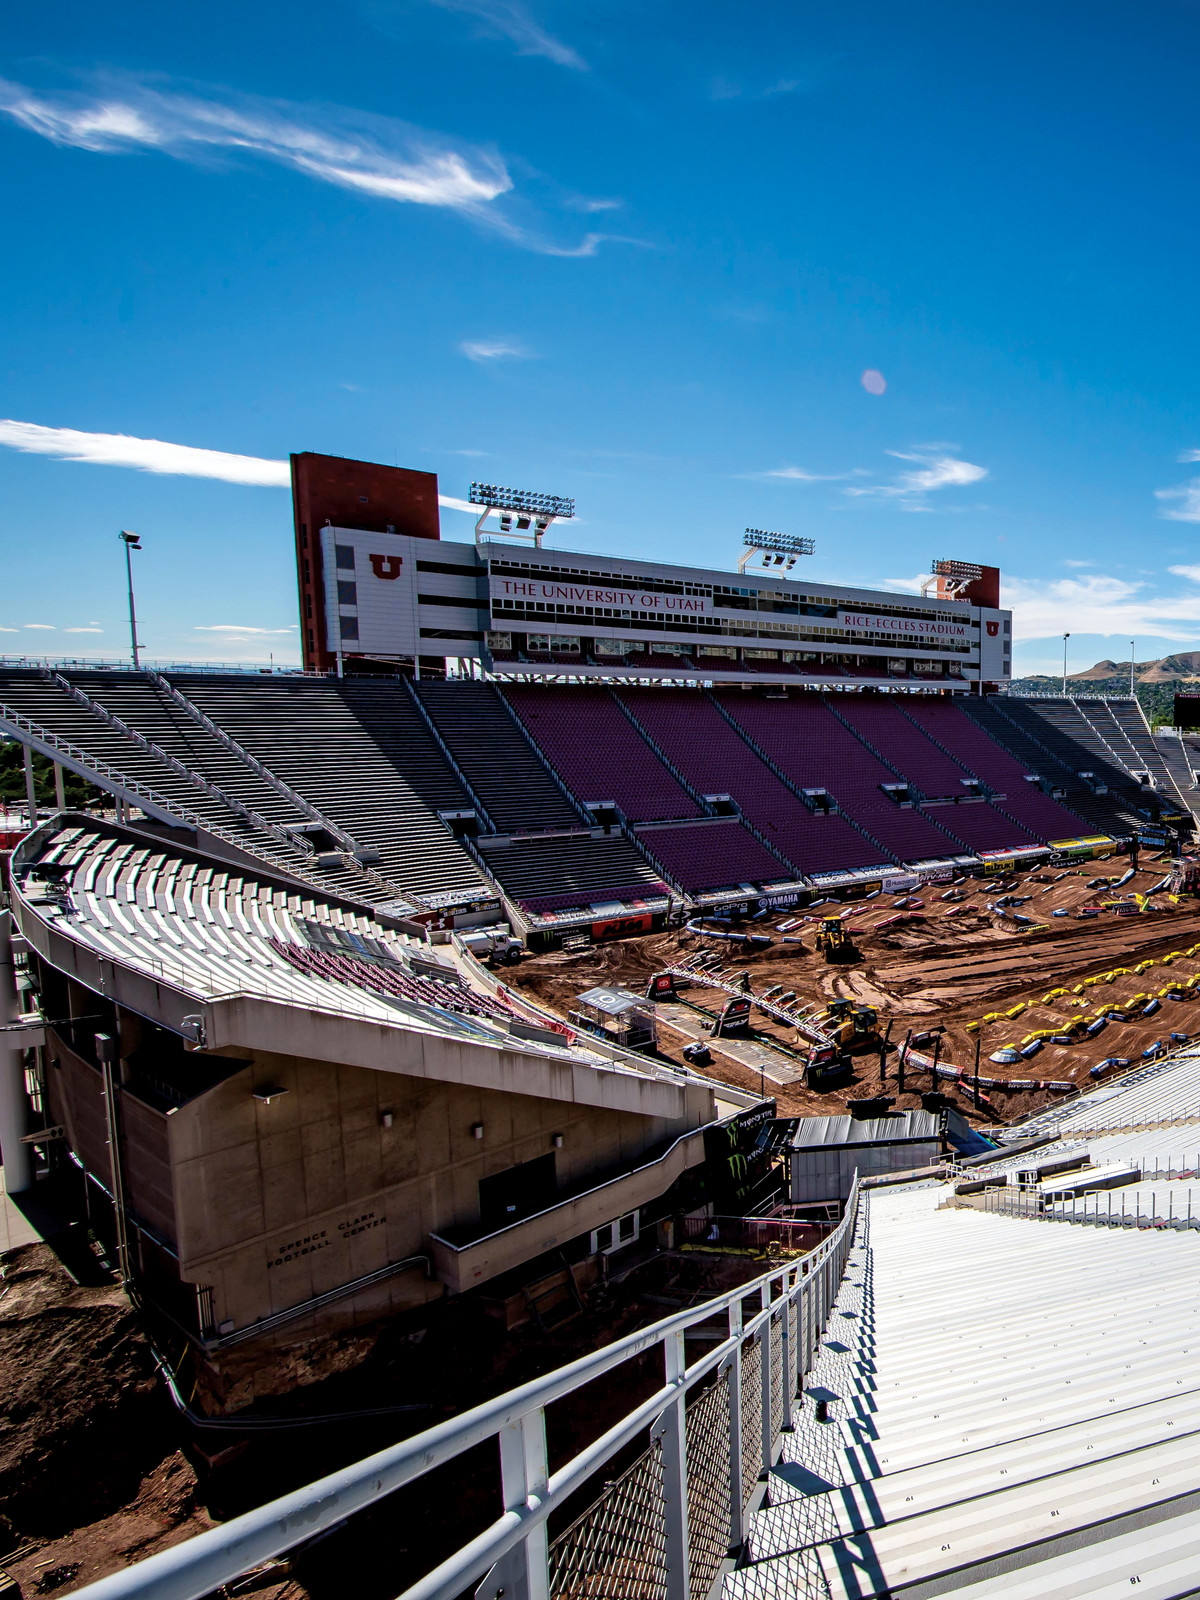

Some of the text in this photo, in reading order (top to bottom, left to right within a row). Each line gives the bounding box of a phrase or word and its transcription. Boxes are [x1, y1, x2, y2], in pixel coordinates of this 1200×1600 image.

[368, 553, 403, 580] U
[502, 580, 705, 612] THE UNIVERSITY OF UTAH
[844, 615, 965, 635] RICE-ECCLES STADIUM
[985, 620, 1000, 637] U
[985, 861, 1014, 872] SUZUKI
[713, 901, 748, 913] GoPro
[767, 893, 799, 907] YAMAHA
[602, 919, 644, 936] KTM
[279, 1211, 376, 1254] SPENCE CLARK
[266, 1216, 387, 1270] FOOTBALL CENTER
